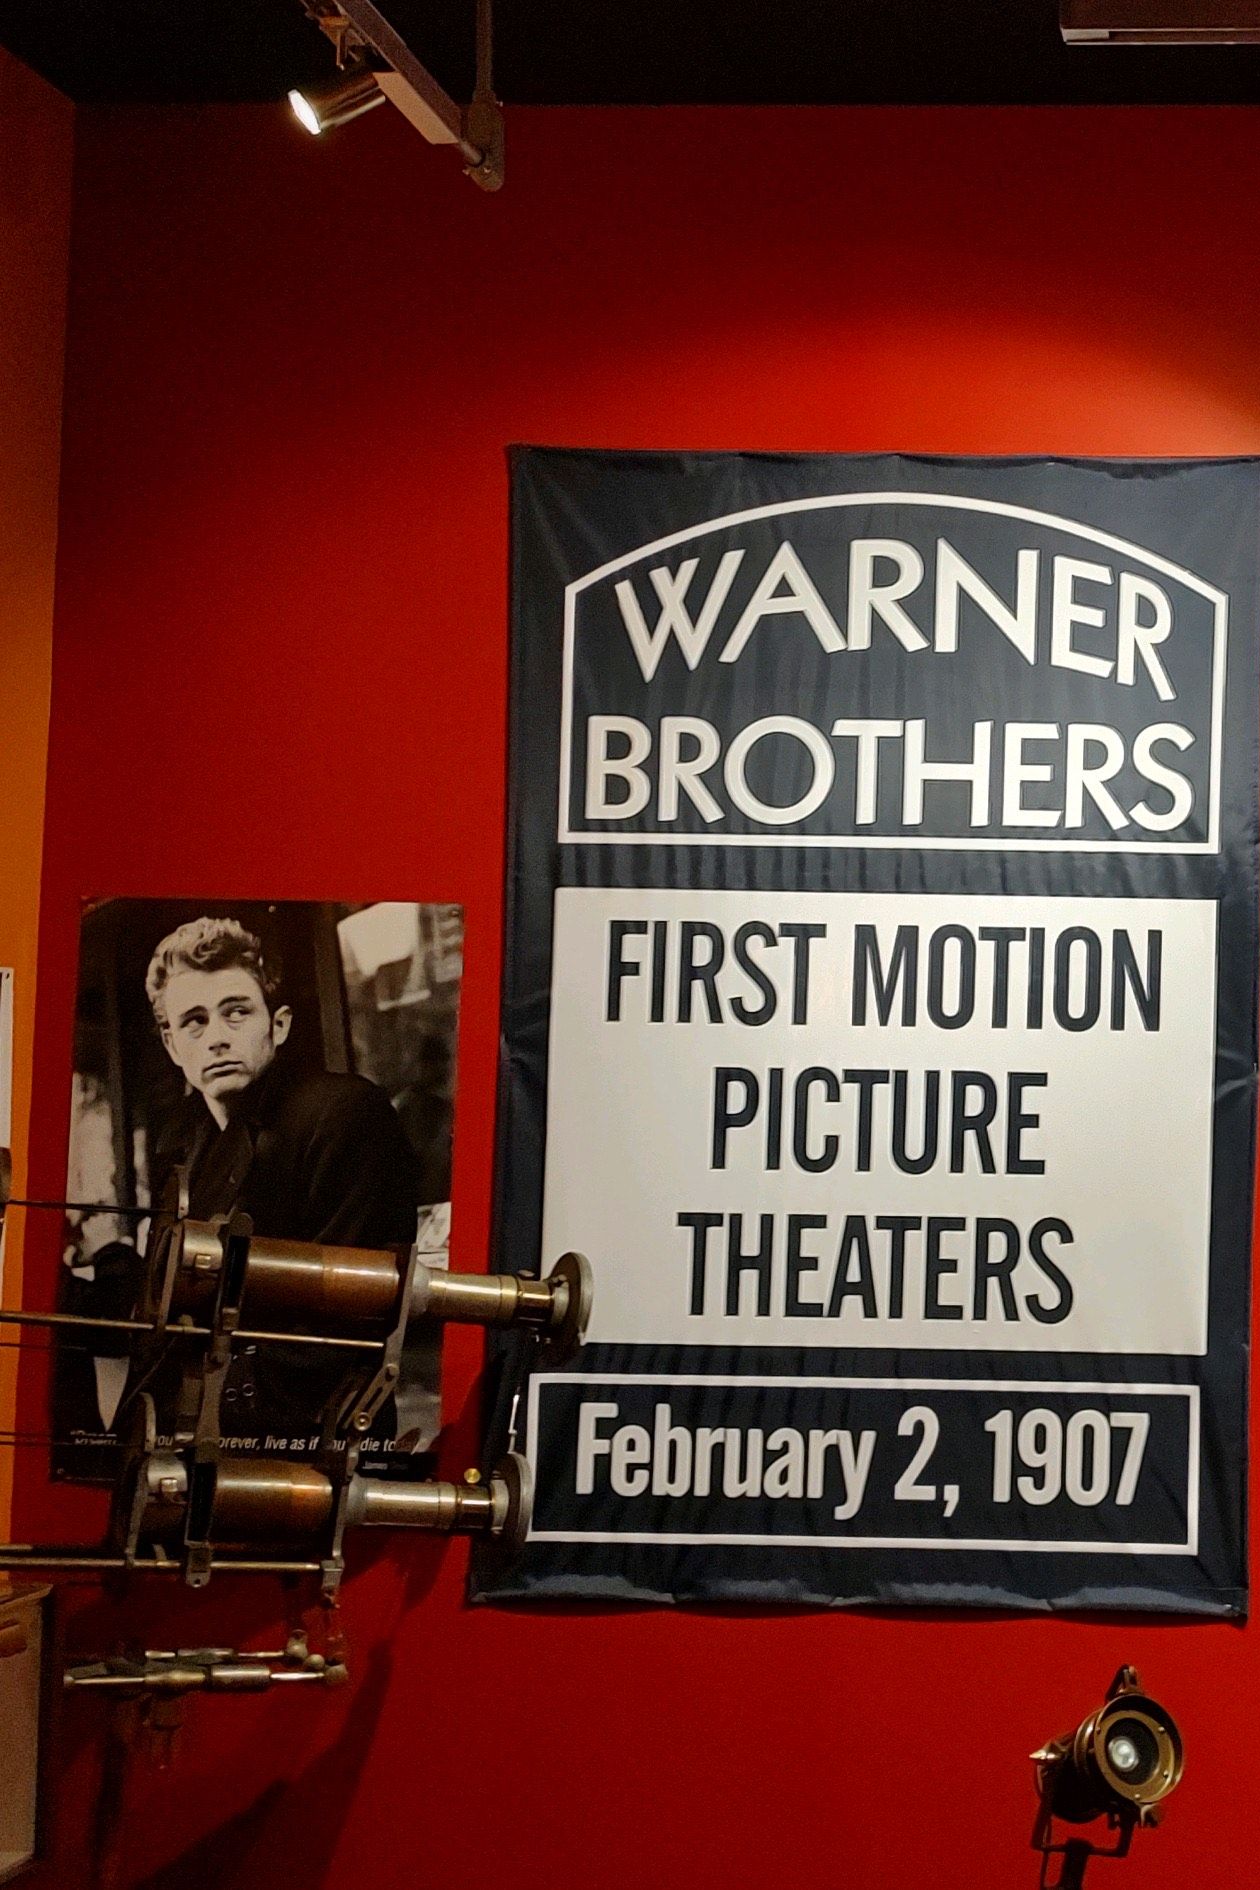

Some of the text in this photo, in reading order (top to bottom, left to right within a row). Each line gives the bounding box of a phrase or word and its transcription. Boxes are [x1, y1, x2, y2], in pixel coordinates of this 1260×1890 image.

[614, 536, 1177, 702] WARNER
[585, 715, 1196, 832] BROTHERS
[605, 919, 1163, 1032] FIRST MOTION
[710, 1066, 1049, 1175] PICTURE
[677, 1211, 1075, 1325] THEATERS
[219, 1436, 261, 1451] orever,
[264, 1435, 288, 1451] live
[290, 1438, 305, 1451] as
[308, 1436, 321, 1451] if
[360, 1437, 380, 1452] die
[575, 1402, 1152, 1521] February 2, 1907
